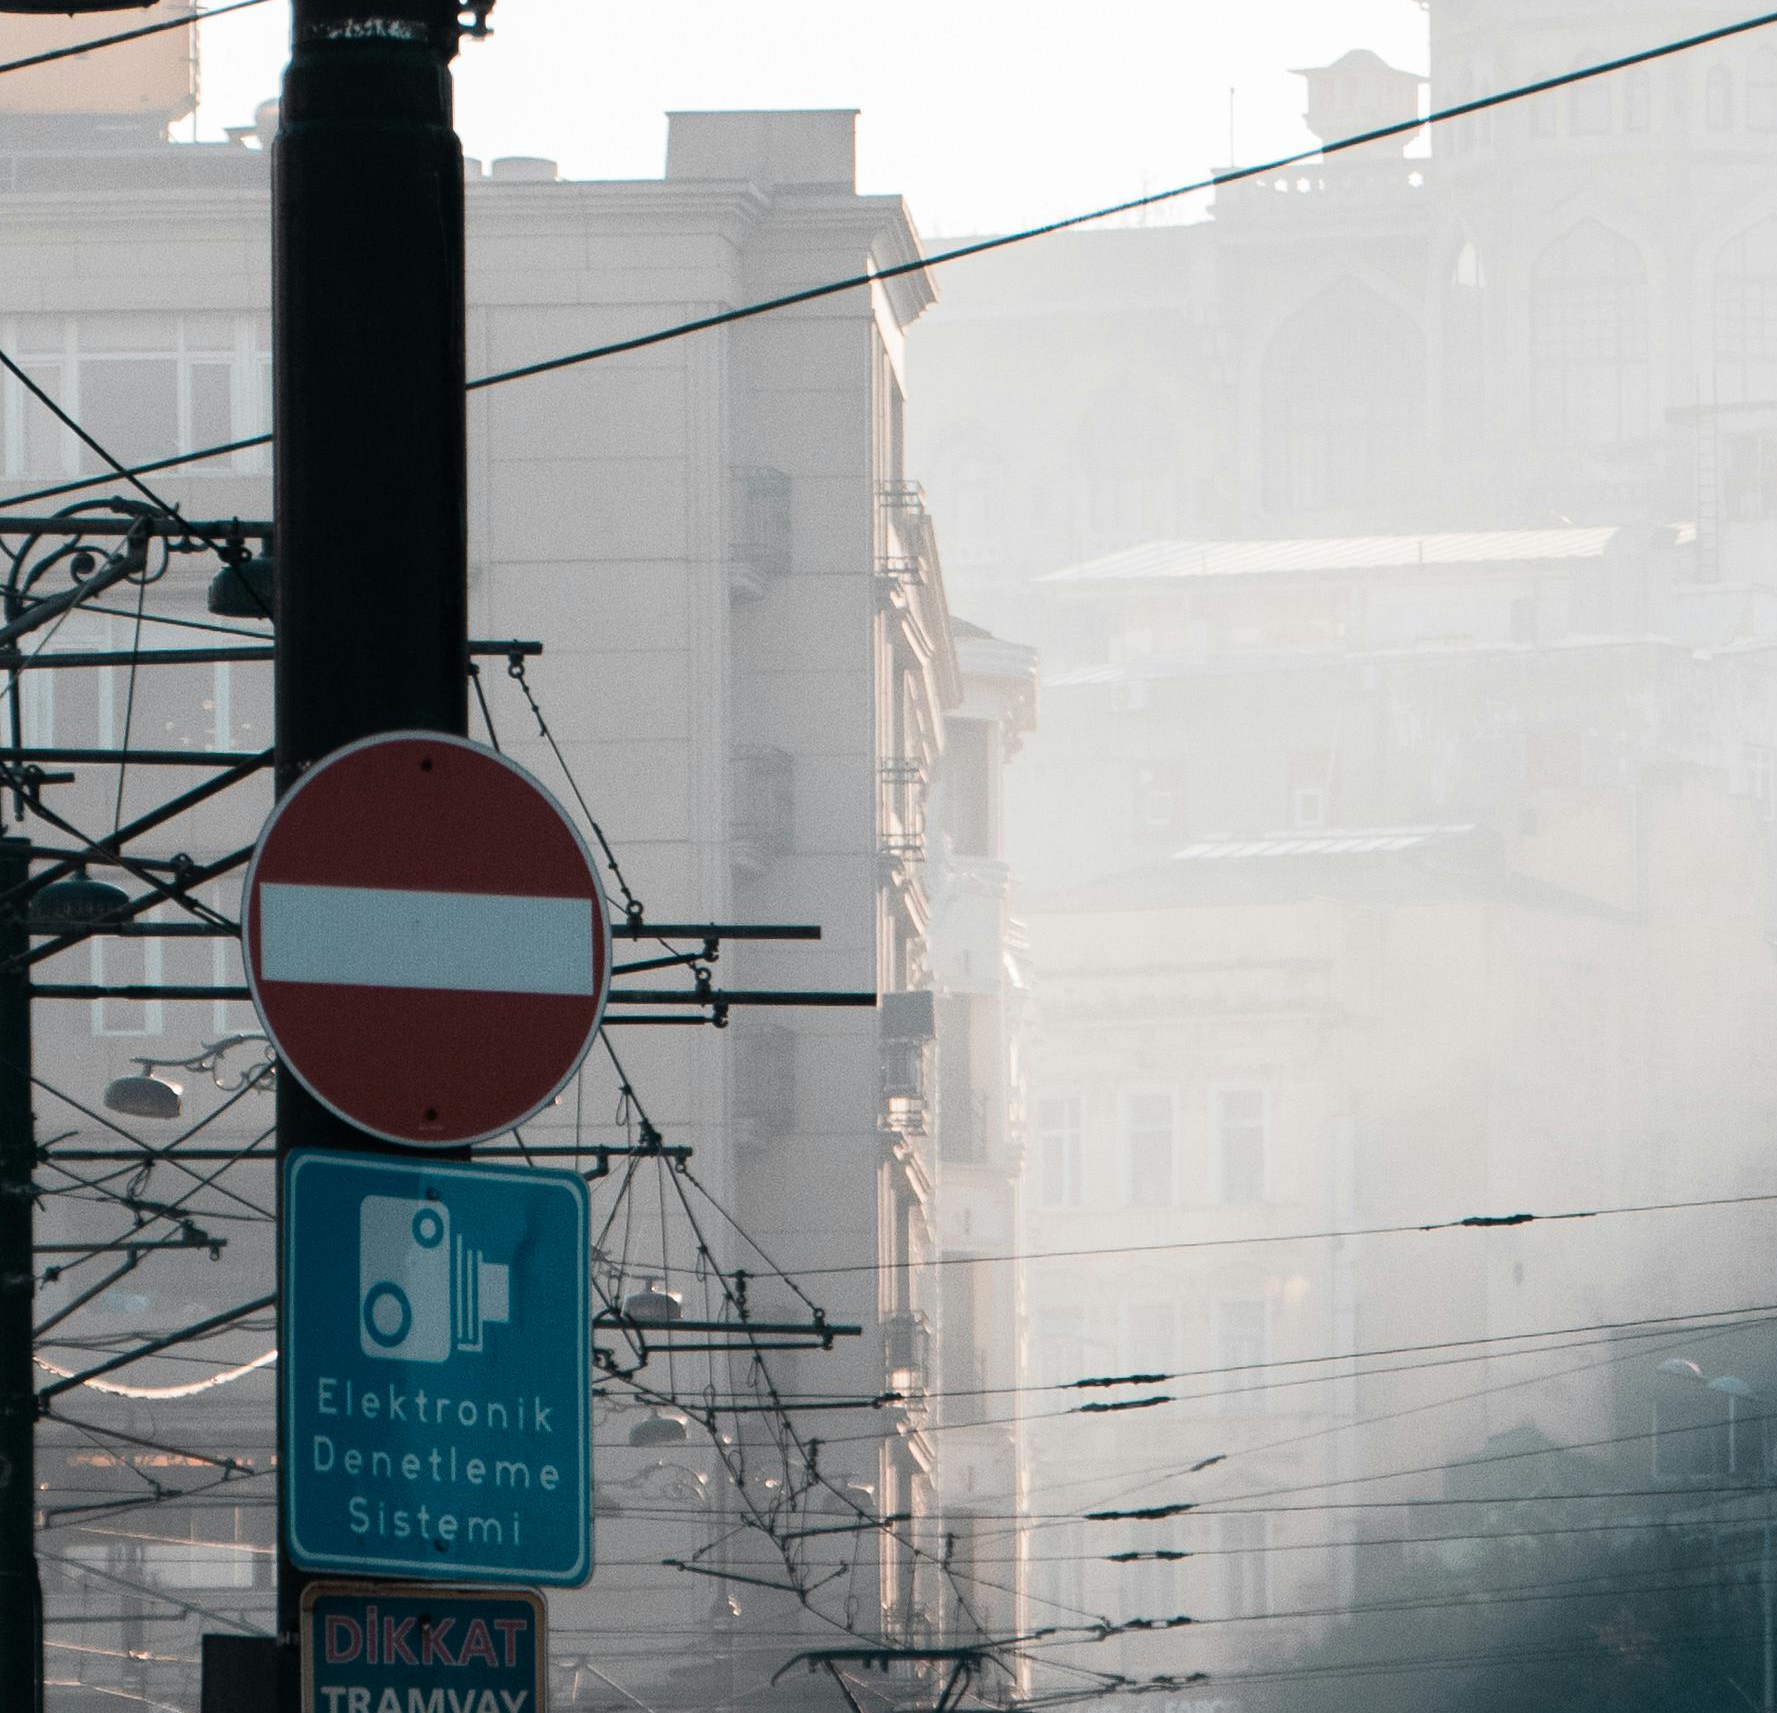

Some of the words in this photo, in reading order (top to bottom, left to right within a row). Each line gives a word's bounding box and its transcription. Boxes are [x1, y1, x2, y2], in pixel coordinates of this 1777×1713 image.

[316, 1376, 555, 1433] Elektronik
[312, 1436, 561, 1492] Denetleme
[347, 1497, 523, 1547] Sistemi
[323, 1605, 528, 1669] DİKKAT
